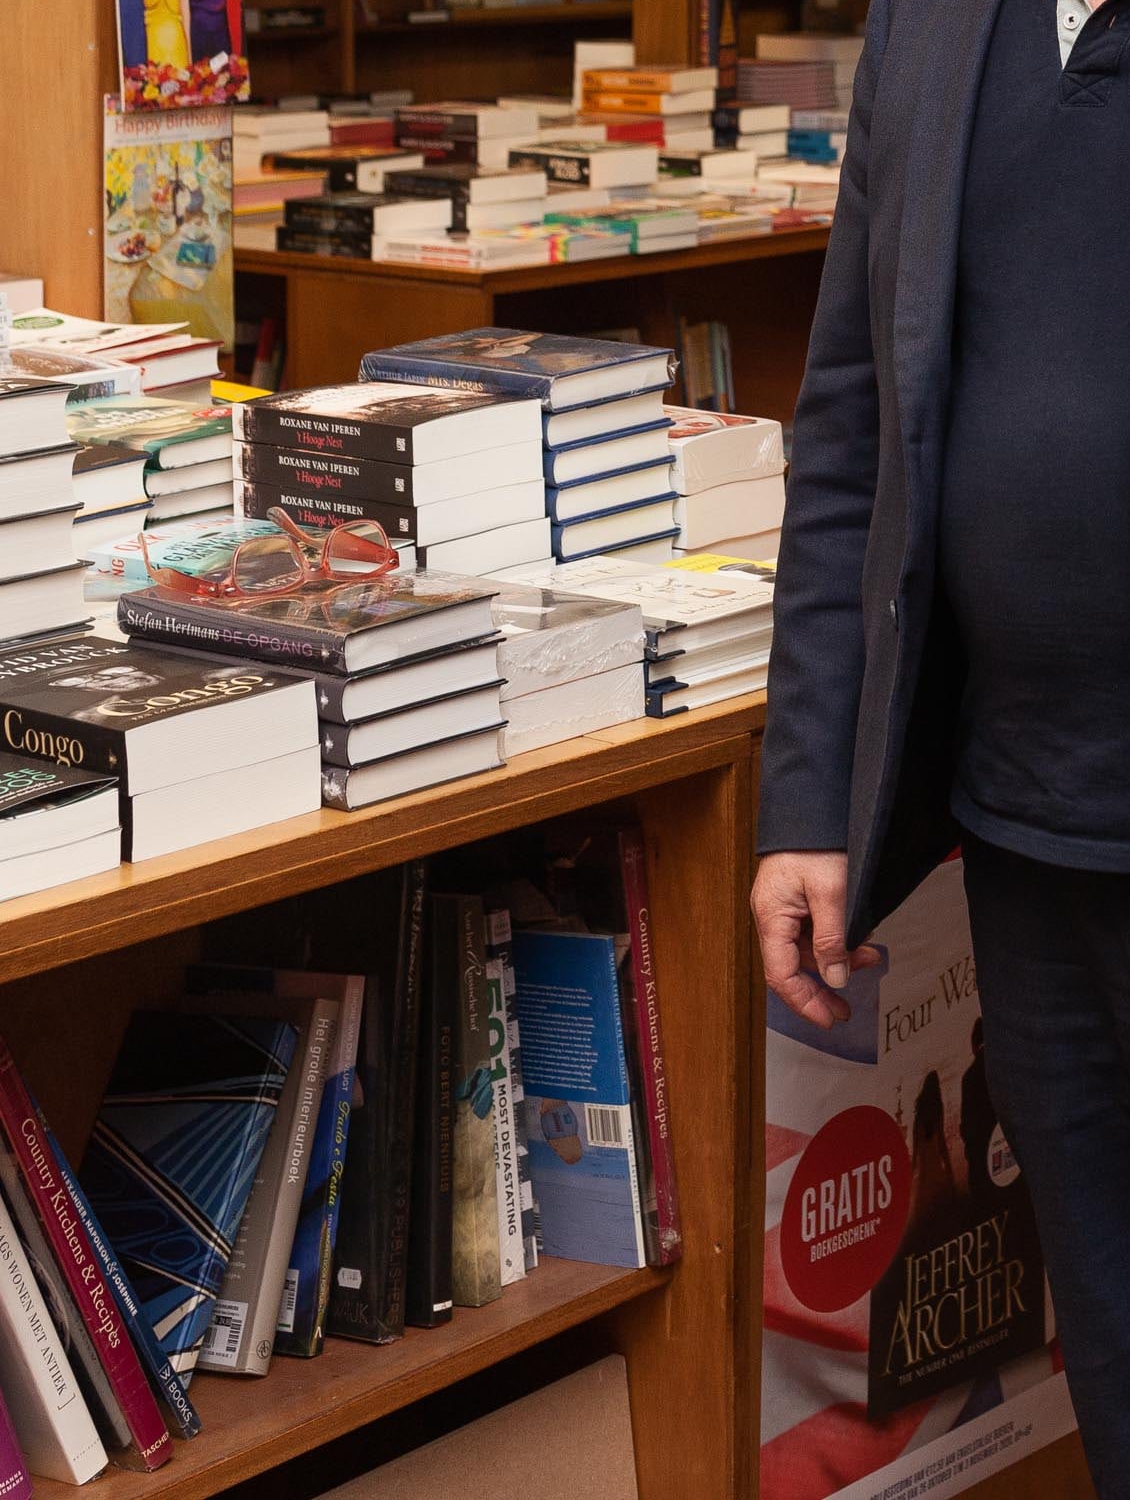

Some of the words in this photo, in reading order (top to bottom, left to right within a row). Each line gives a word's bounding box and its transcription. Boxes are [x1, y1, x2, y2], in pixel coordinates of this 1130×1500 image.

[115, 116, 160, 137] Happy
[428, 374, 452, 389] Mrs.
[453, 378, 485, 393] Degas
[280, 416, 313, 431] ROXANE
[313, 421, 330, 433] VAN
[331, 424, 361, 437] IPEREN
[302, 432, 326, 449] Hooge
[326, 436, 344, 449] Nest
[278, 455, 312, 470] ROXANE
[312, 459, 329, 472] VAN
[330, 463, 360, 476] IPEREN
[302, 470, 324, 488] Hooge
[324, 475, 341, 488] Nest
[280, 494, 314, 509] ROXANE
[314, 499, 332, 512] VAN
[333, 502, 364, 516] IPEREN
[303, 510, 327, 528] Hooge
[327, 514, 345, 526] Nest
[40, 644, 95, 658] VAN
[126, 609, 164, 633] Stefan
[164, 616, 221, 642] Hertmans
[222, 629, 243, 646] DE
[247, 633, 314, 659] OPGANG
[0, 646, 130, 680] YBROUCK
[97, 675, 264, 717] Congo
[4, 710, 84, 768] Congo
[638, 907, 652, 975] Country
[645, 980, 660, 1053] Kitchens
[883, 999, 934, 1055] Four
[938, 955, 979, 1012] Wa
[316, 1017, 329, 1039] Het
[307, 1043, 323, 1084] grote
[652, 1056, 664, 1074] &
[496, 1083, 510, 1127] MOST
[653, 1076, 669, 1141] Recipes
[287, 1086, 312, 1185] interieurboek
[499, 1129, 518, 1237] DEVASTATING
[800, 1154, 894, 1244] GRATIS
[22, 1118, 57, 1191] Country
[50, 1188, 87, 1267] Kitchens
[81, 1265, 96, 1286] &
[89, 1281, 121, 1350] Recipes
[60, 1170, 87, 1227] ALEXANDER,
[85, 1218, 111, 1266] NAPOLEON
[112, 1272, 139, 1318] JOSÉPHINE
[902, 1209, 1010, 1314] JEFFREY
[8, 1259, 36, 1317] WONEN
[28, 1311, 48, 1345] MET
[40, 1345, 68, 1397] ANTIEK
[881, 1257, 1027, 1379] ARCHER
[167, 1382, 194, 1424] BOOKS
